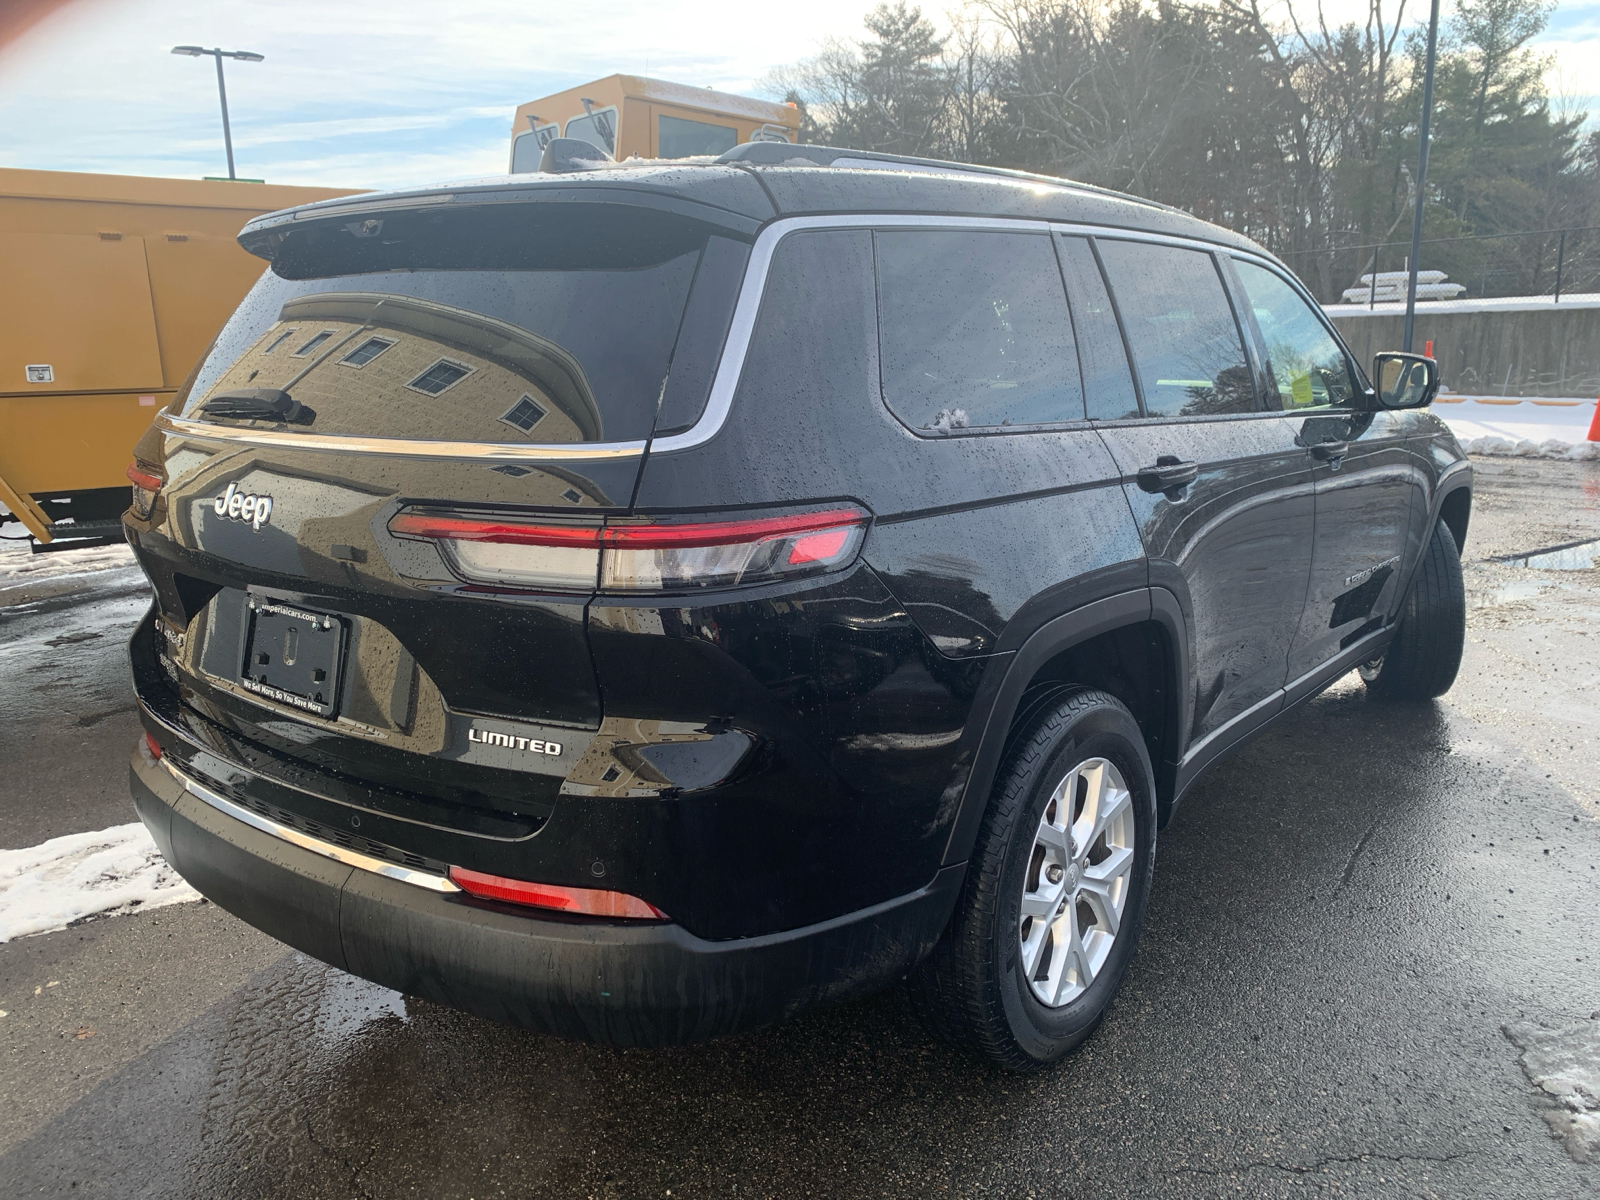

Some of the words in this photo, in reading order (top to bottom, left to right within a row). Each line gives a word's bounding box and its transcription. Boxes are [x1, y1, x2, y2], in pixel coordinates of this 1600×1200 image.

[214, 482, 273, 533] Jeep
[243, 680, 252, 689] We
[252, 682, 260, 691] Sell
[261, 685, 275, 698] More,
[275, 691, 283, 700] So
[283, 692, 294, 703] You
[294, 697, 307, 708] Save
[307, 702, 322, 713] More
[469, 728, 563, 756] LIMITED
